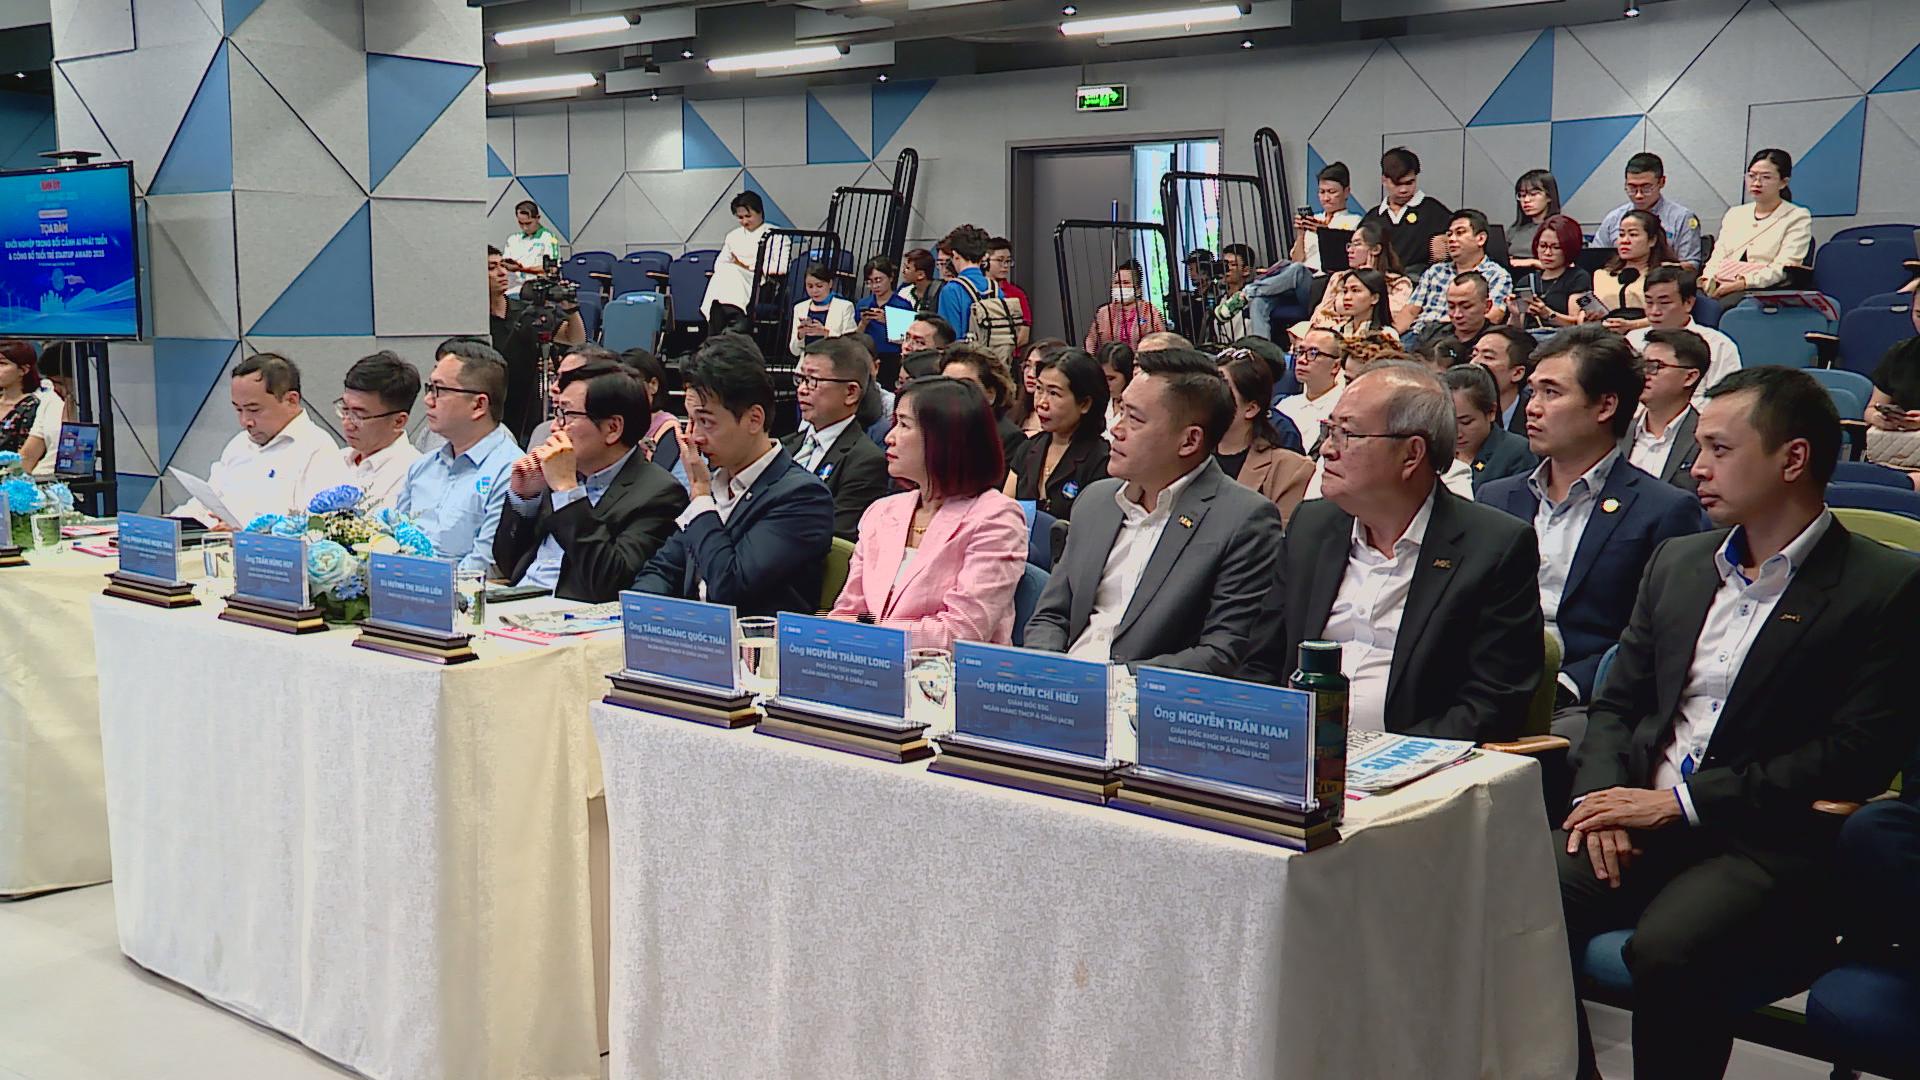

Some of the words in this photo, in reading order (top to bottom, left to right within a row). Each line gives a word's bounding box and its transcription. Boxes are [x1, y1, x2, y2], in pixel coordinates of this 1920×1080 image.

[790, 643, 805, 657] Ông
[868, 659, 890, 669] LONG
[976, 678, 995, 693] Ông
[998, 683, 1035, 697] NGUYỄN
[1154, 705, 1176, 722] Ông
[1178, 712, 1224, 729] NGUYỄN
[1260, 726, 1289, 740] NAM
[1170, 727, 1187, 735] GIÁM
[1220, 735, 1238, 744] NGÂN
[1168, 737, 1186, 745] NGÂN
[1188, 739, 1206, 749] HÀNG
[1208, 743, 1225, 752] TMCP
[1232, 748, 1250, 757] CHÂU
